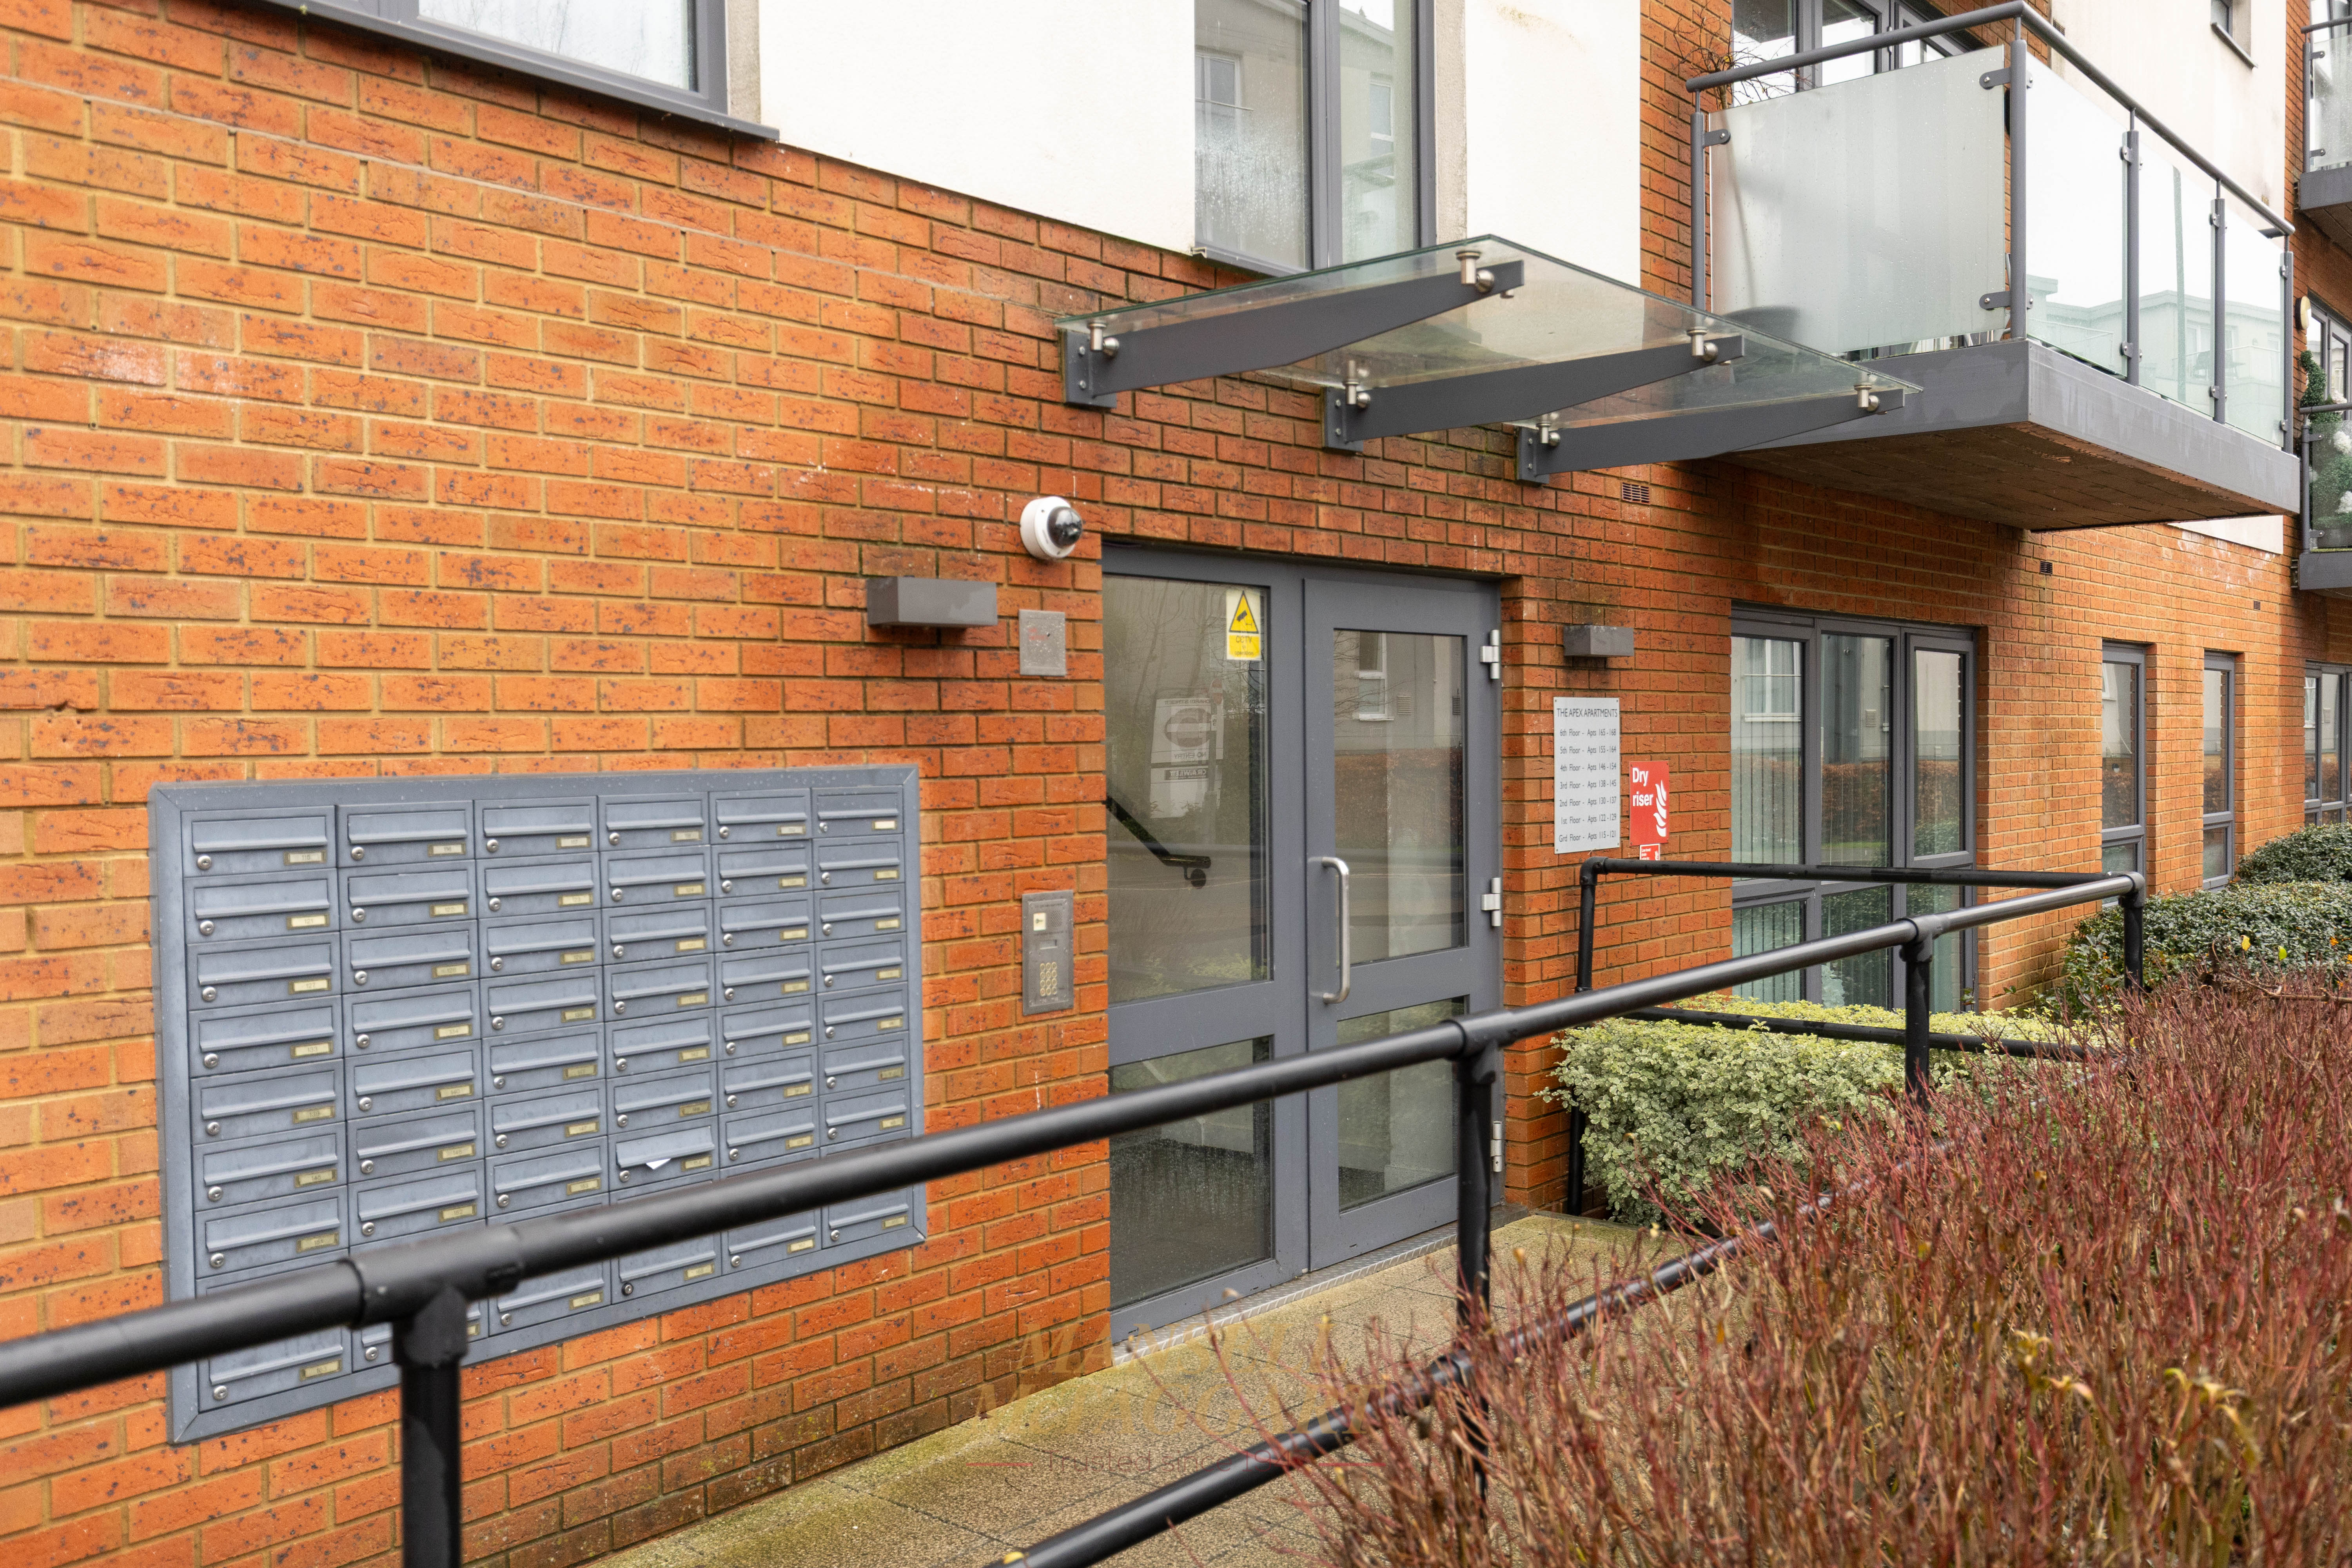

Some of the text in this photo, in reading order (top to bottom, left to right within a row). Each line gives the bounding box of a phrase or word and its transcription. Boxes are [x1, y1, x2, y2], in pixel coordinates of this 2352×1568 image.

[1557, 708, 1617, 717] THE APEX APARTMENTS
[1587, 729, 1596, 738] Apts
[1587, 746, 1596, 755] Apts
[1588, 763, 1596, 772] Apts
[1632, 768, 1649, 787] Dry
[1588, 781, 1596, 789] Apts
[1588, 798, 1597, 807] Apts
[1633, 791, 1653, 806] riser
[1588, 815, 1597, 824] Apts
[1588, 833, 1597, 841] Apts
